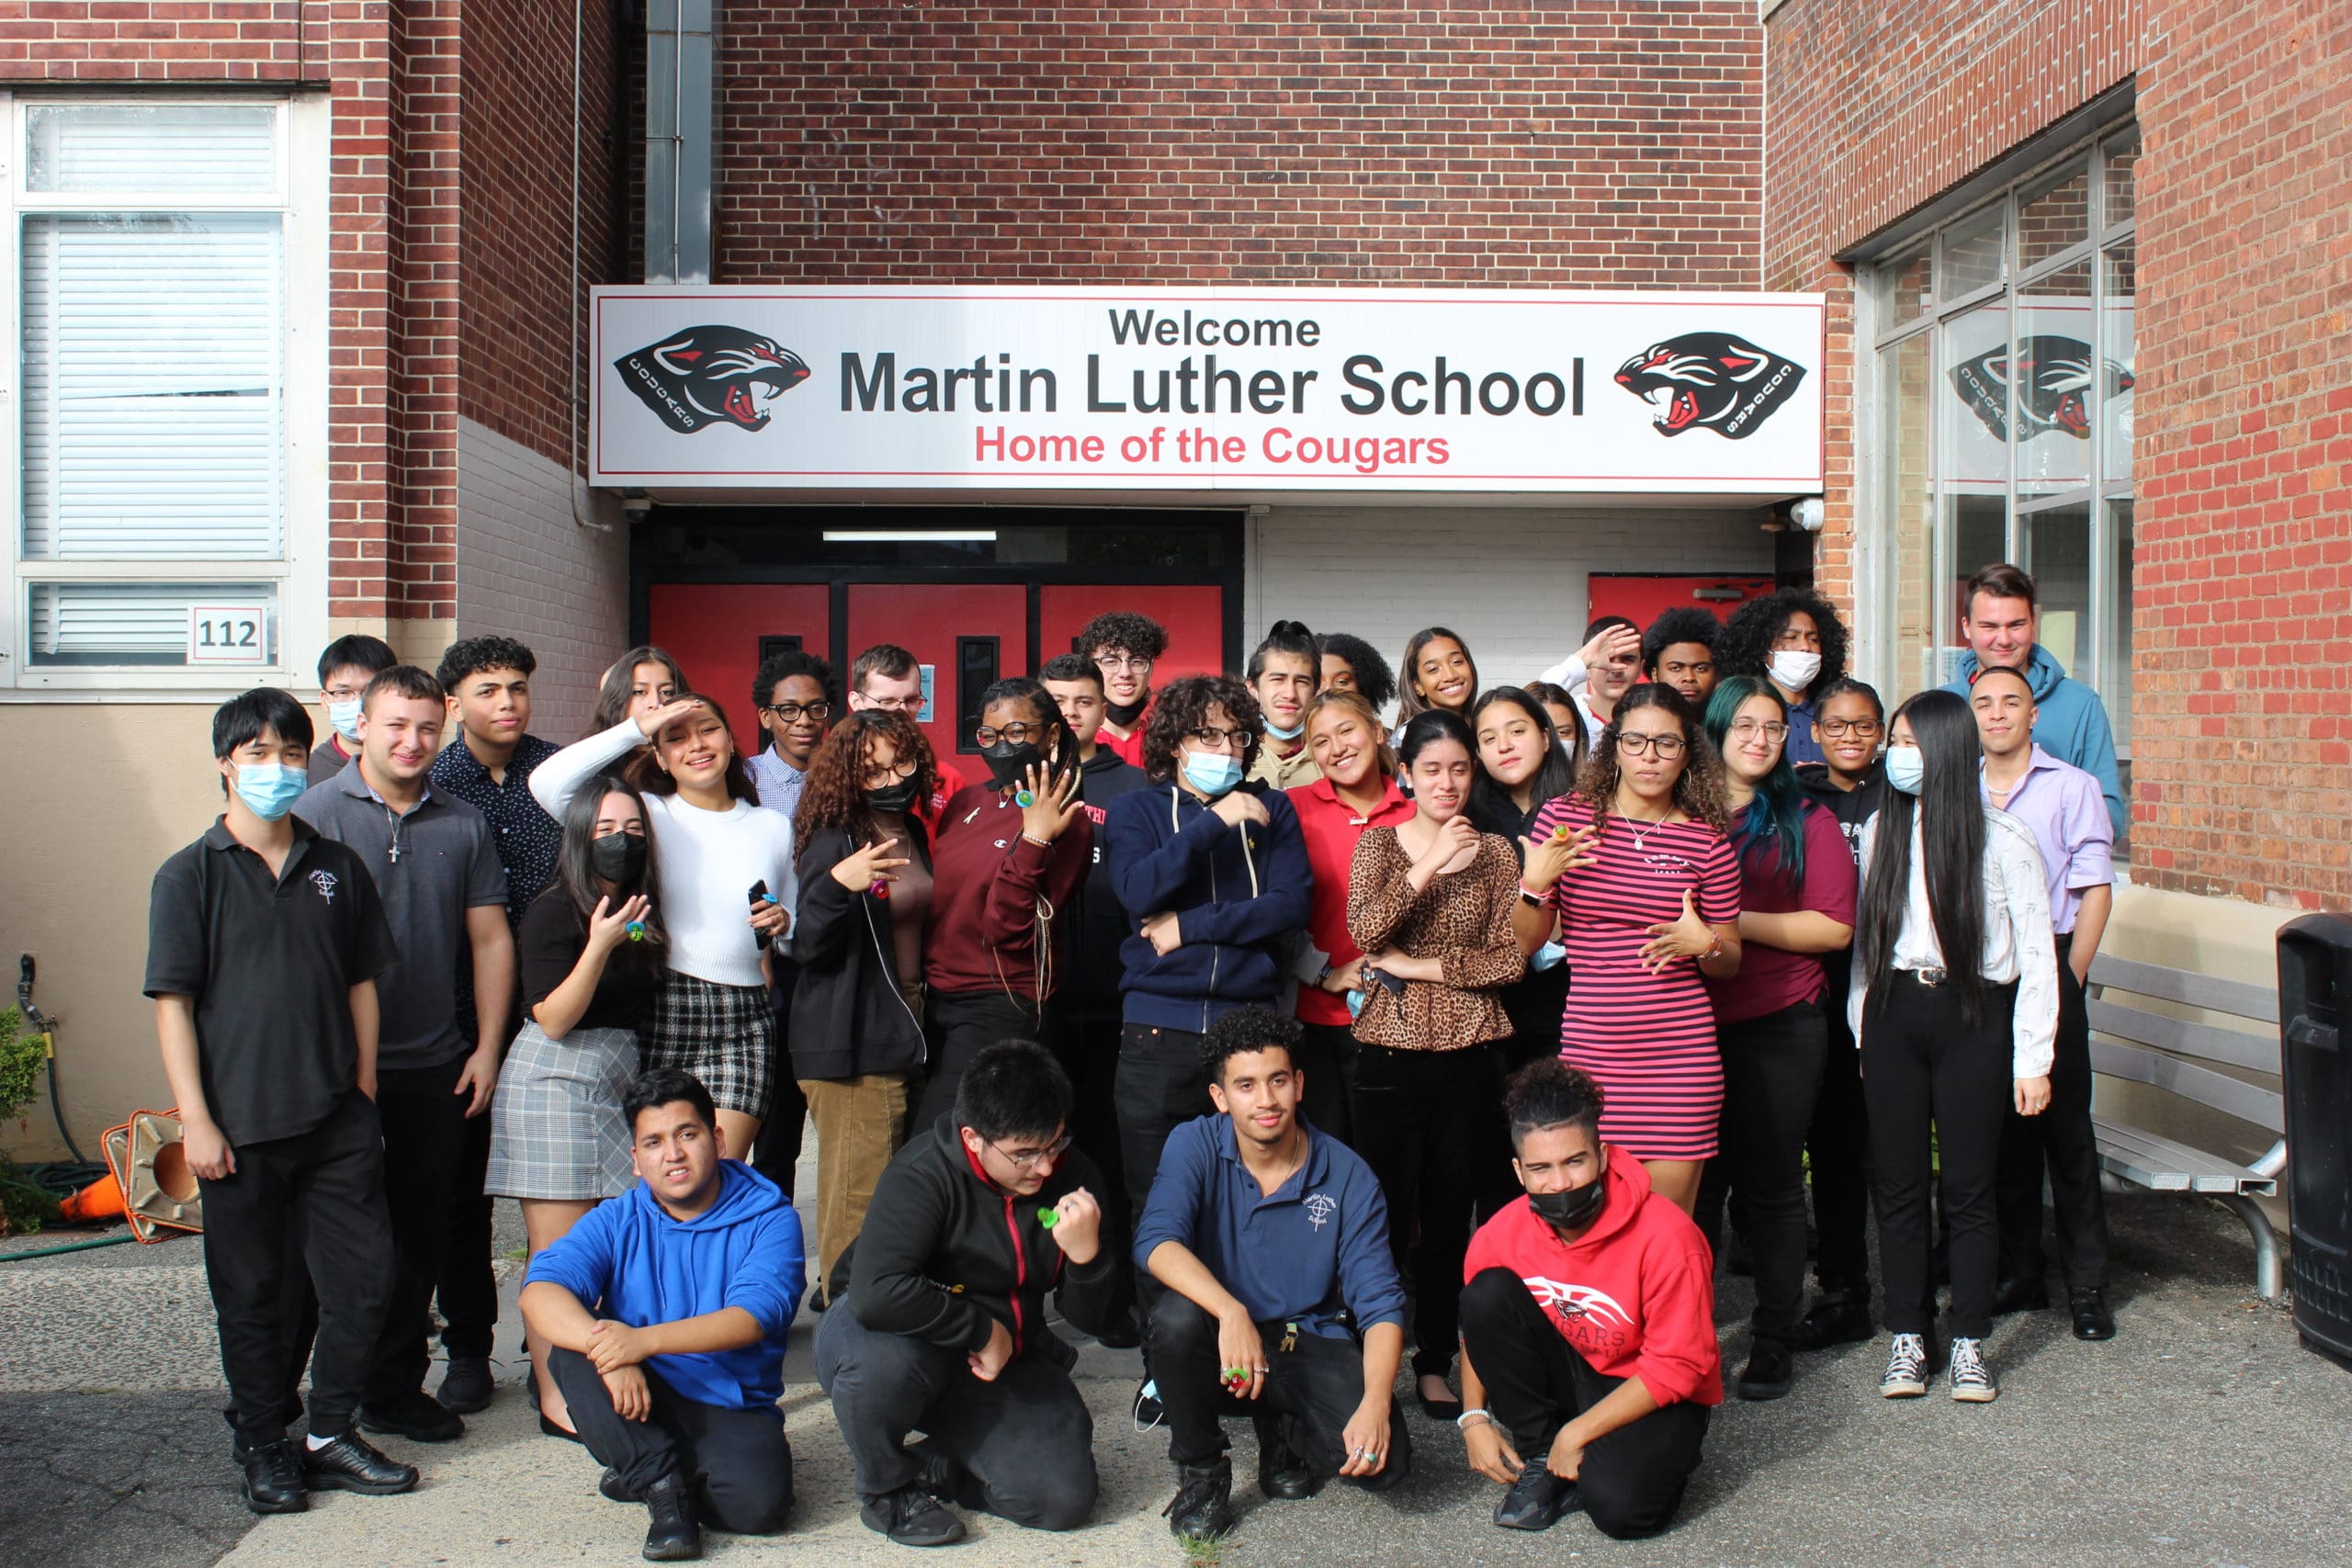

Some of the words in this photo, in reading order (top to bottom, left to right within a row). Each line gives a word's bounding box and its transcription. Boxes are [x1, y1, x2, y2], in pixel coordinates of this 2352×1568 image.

[1108, 310, 1320, 346] Welcome
[629, 358, 695, 427] COUGARS
[841, 352, 1057, 412] Martin
[1087, 354, 1318, 414] Luther
[1340, 355, 1584, 416] School
[1727, 365, 1792, 433] COUGARS
[977, 425, 1104, 463] Home
[1121, 426, 1166, 463] of
[1176, 427, 1246, 463] the
[1262, 427, 1450, 473] Cougars
[200, 620, 256, 647] 112
